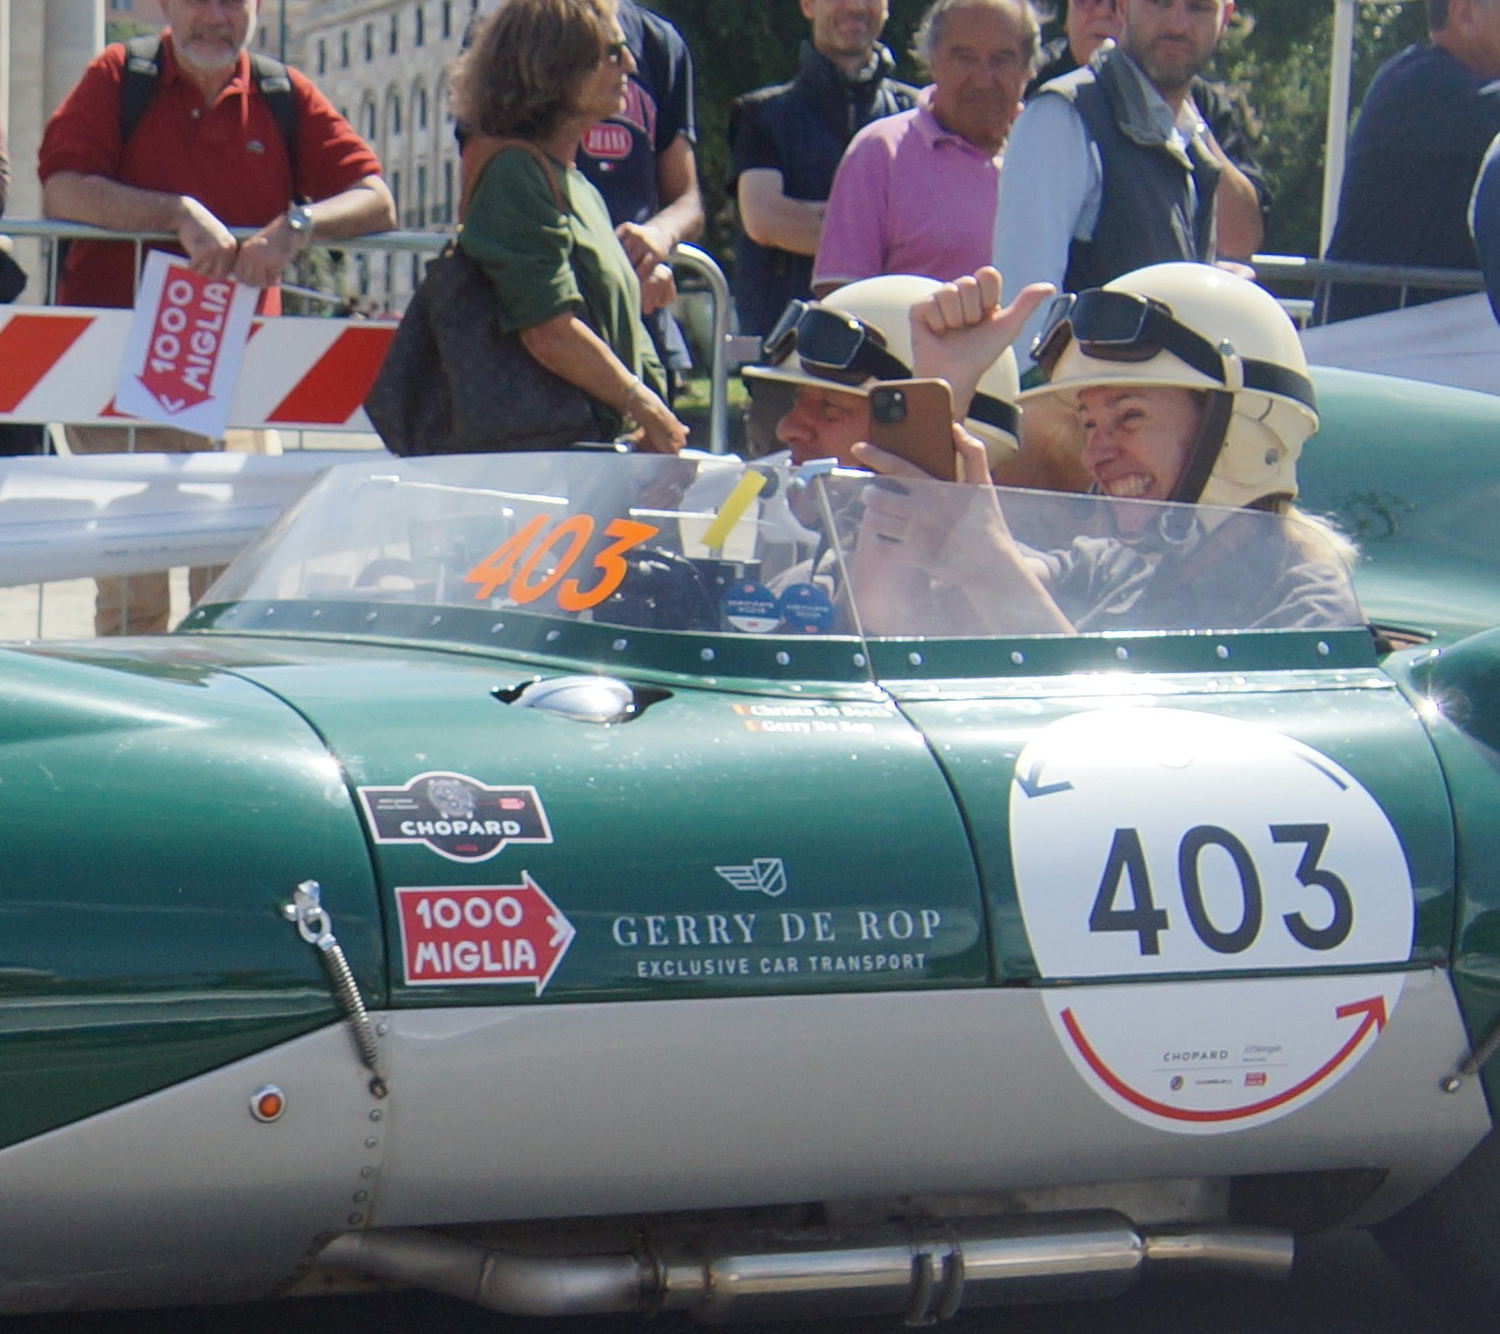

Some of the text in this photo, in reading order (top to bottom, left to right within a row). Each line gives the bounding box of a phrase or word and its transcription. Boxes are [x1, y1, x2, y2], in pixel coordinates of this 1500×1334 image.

[151, 279, 194, 374] 1000
[181, 282, 231, 392] MIGLIA
[464, 513, 660, 612] 403
[400, 819, 521, 836] CHOPARD
[1088, 823, 1354, 956] 403
[415, 896, 523, 929] 1000
[611, 909, 941, 946] GERRY DE ROP
[414, 939, 537, 974] MIGLIA
[637, 952, 926, 978] EXCLUSIVE CAR TRANSPORT
[1163, 1049, 1229, 1063] CHOPARD
